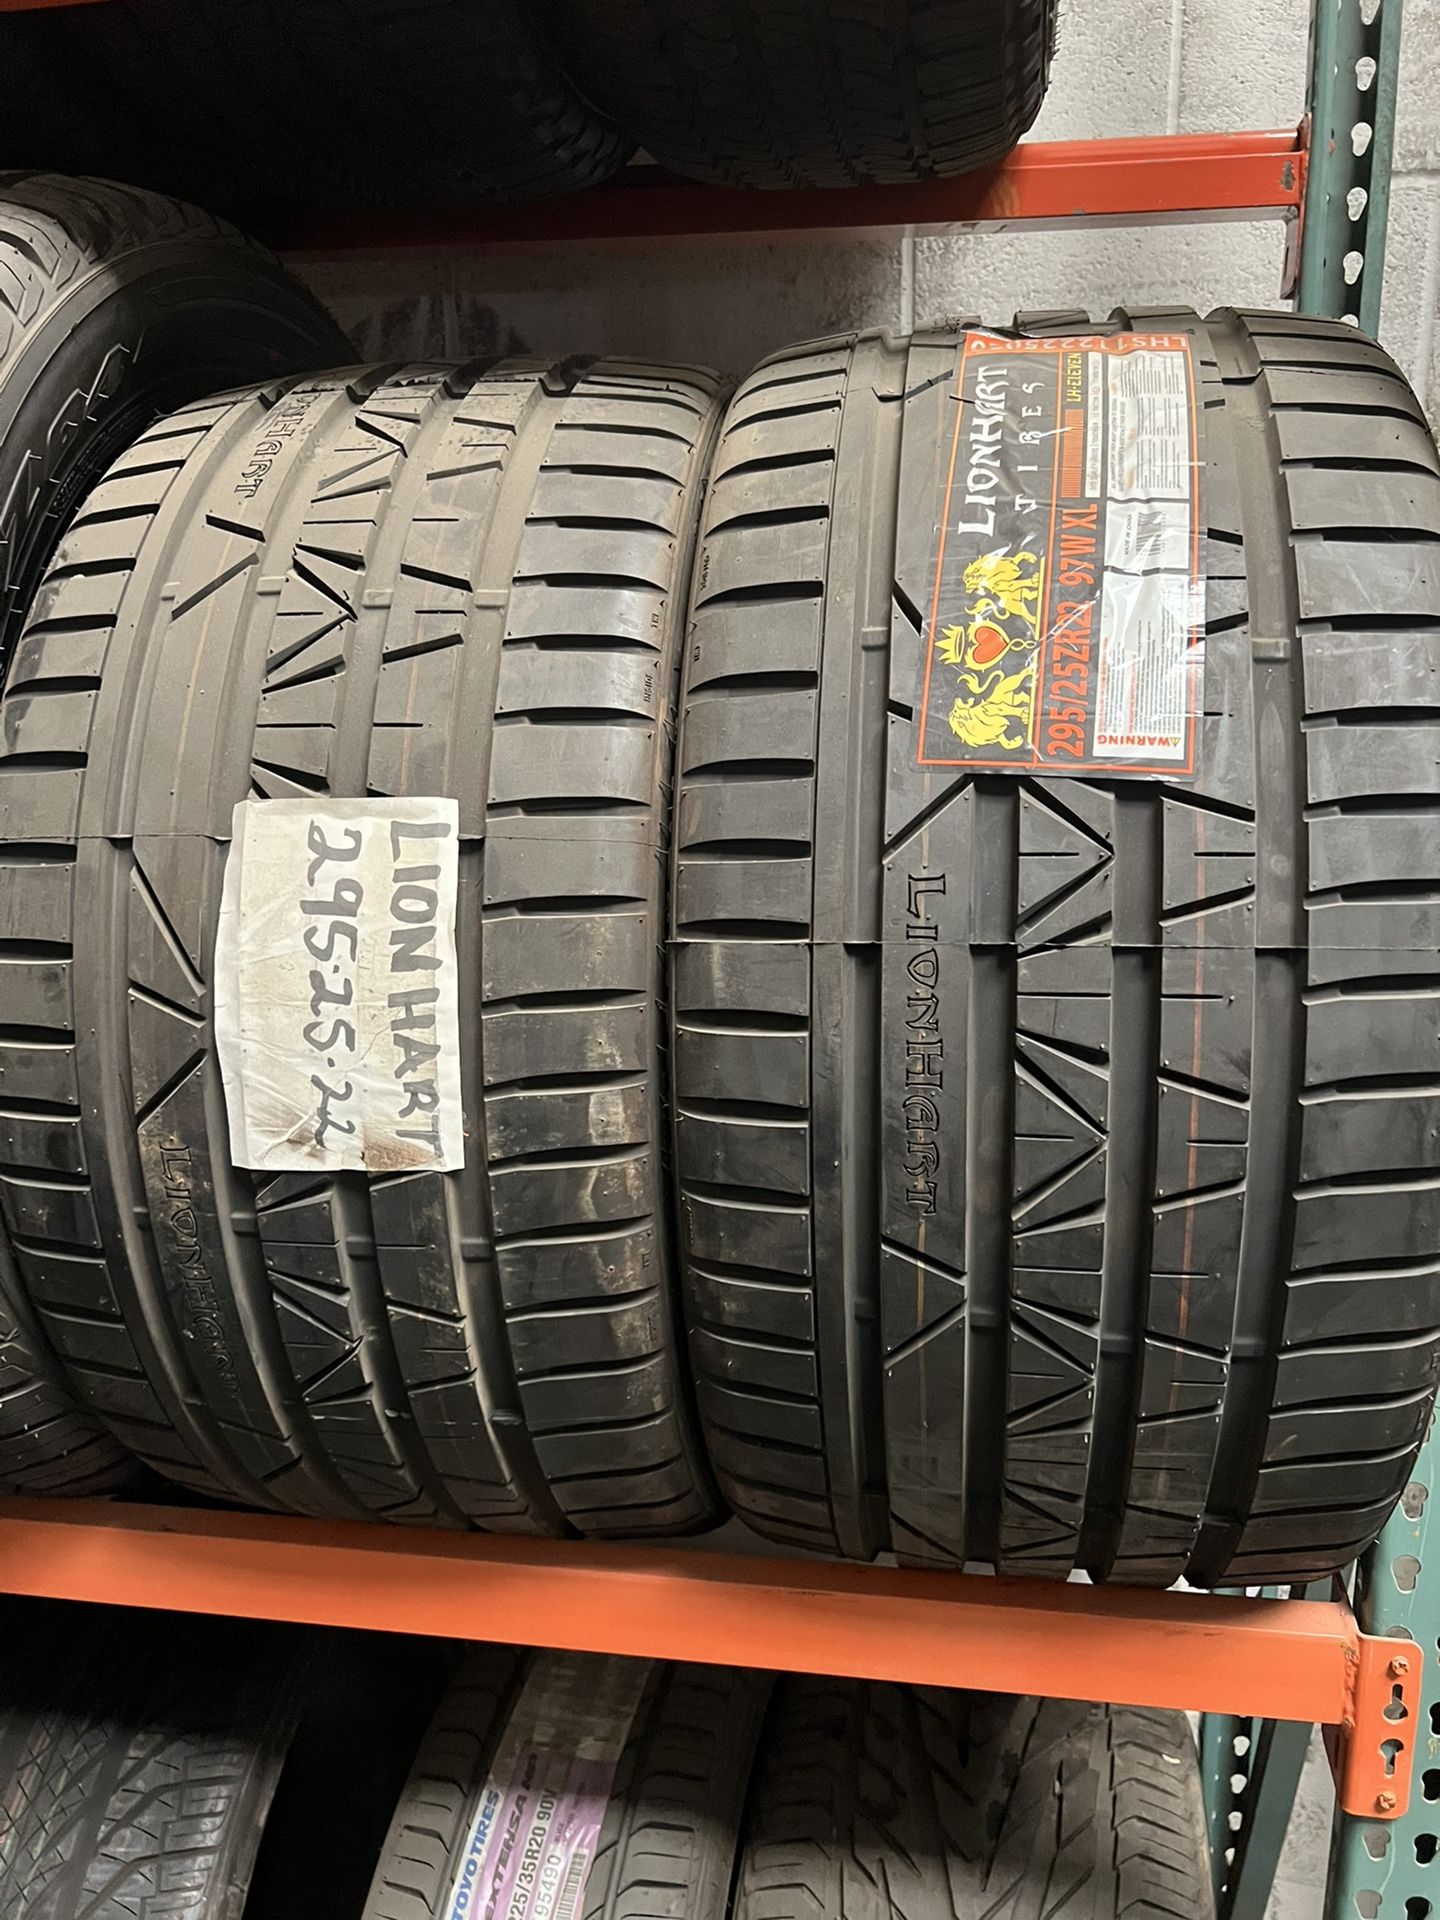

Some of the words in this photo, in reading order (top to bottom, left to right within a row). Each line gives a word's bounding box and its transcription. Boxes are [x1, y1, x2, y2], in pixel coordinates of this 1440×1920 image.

[958, 366, 1009, 537] LIONHART
[1014, 382, 1045, 515] TIRES
[1058, 533, 1097, 587] 97W
[1062, 504, 1098, 530] XL
[1047, 601, 1093, 758] 295/25ZR22
[1097, 734, 1170, 747] WARNING
[902, 873, 947, 1217] LIONHART
[470, 1789, 500, 1857] TIRES
[536, 1788, 558, 1822] 90V
[485, 1794, 528, 1920] EXTENSA
